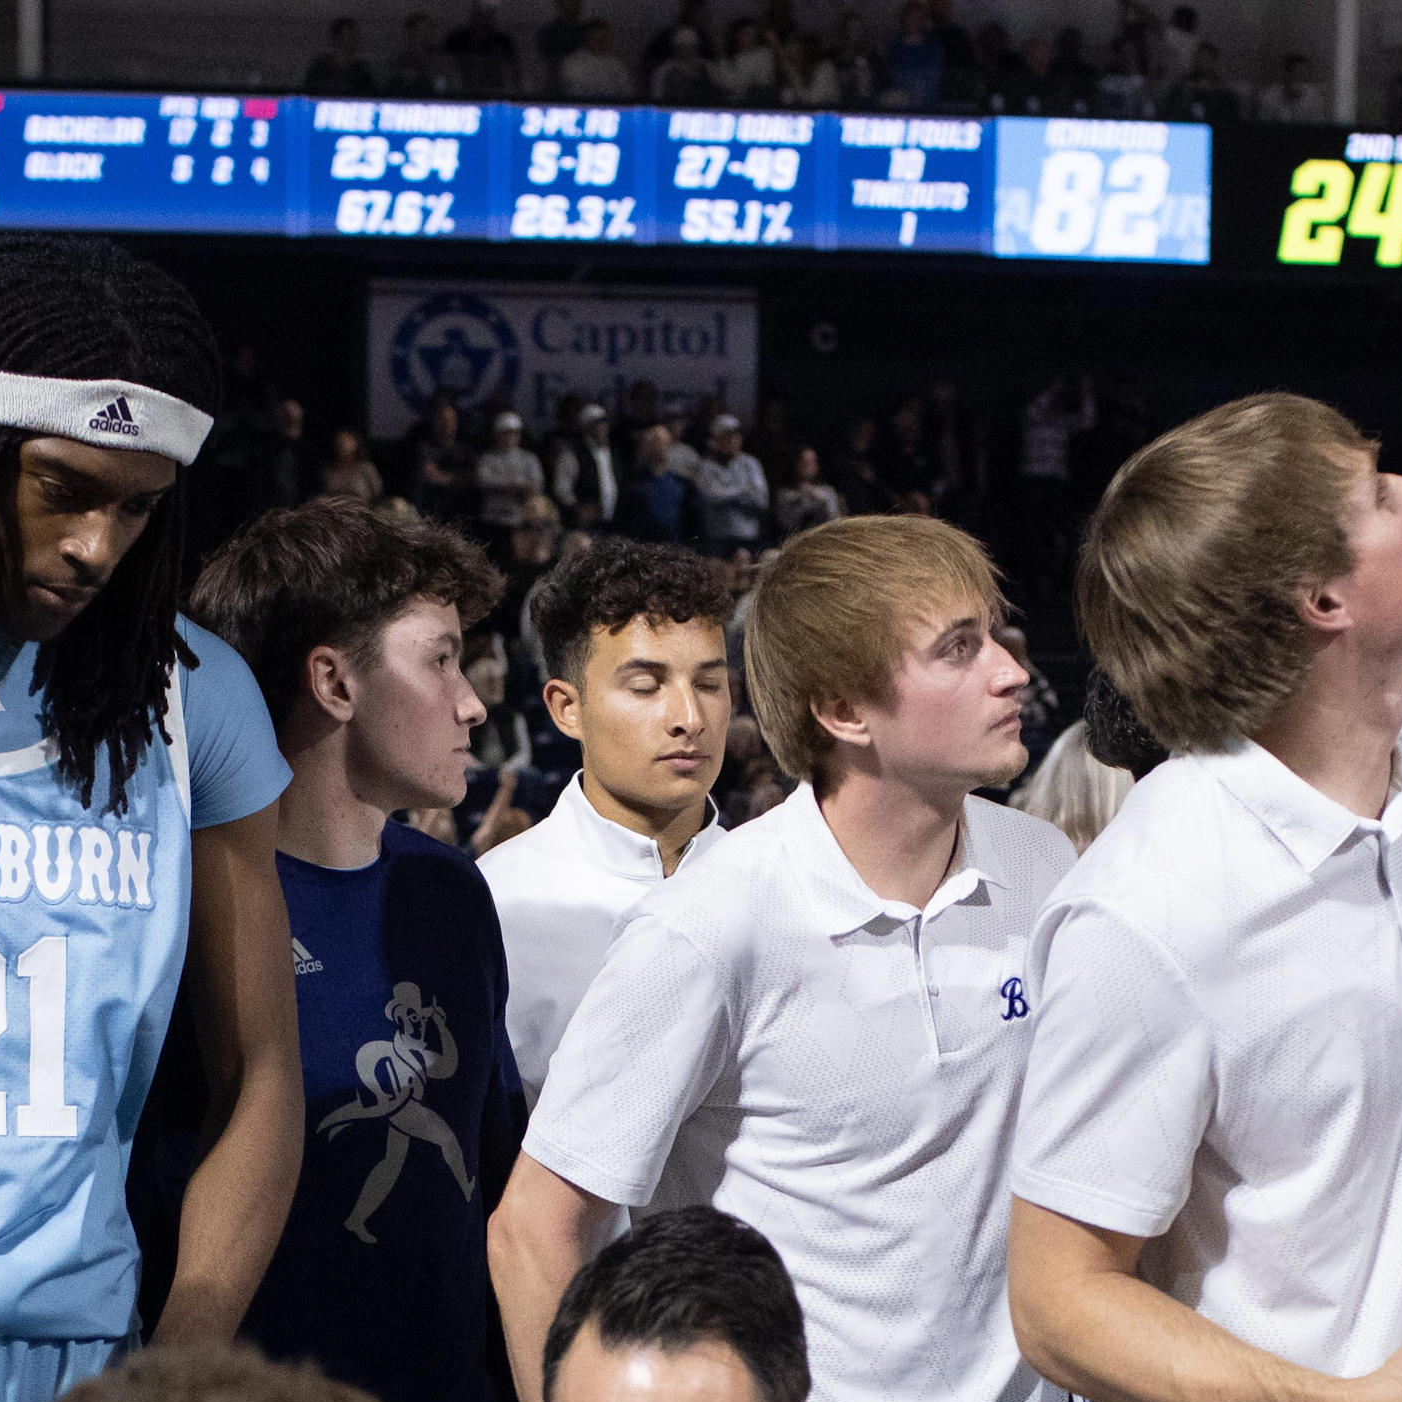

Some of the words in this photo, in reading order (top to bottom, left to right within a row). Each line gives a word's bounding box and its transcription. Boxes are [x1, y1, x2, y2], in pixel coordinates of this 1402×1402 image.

[331, 135, 459, 181] 23-34
[528, 140, 620, 185] 5-19
[674, 145, 800, 191] 27-49
[335, 189, 455, 234] 67.6%
[510, 194, 637, 239] 26.3%
[680, 198, 793, 243] 55.1%
[1030, 150, 1172, 256] 82
[531, 307, 729, 364] Capitol
[88, 417, 139, 437] adidas
